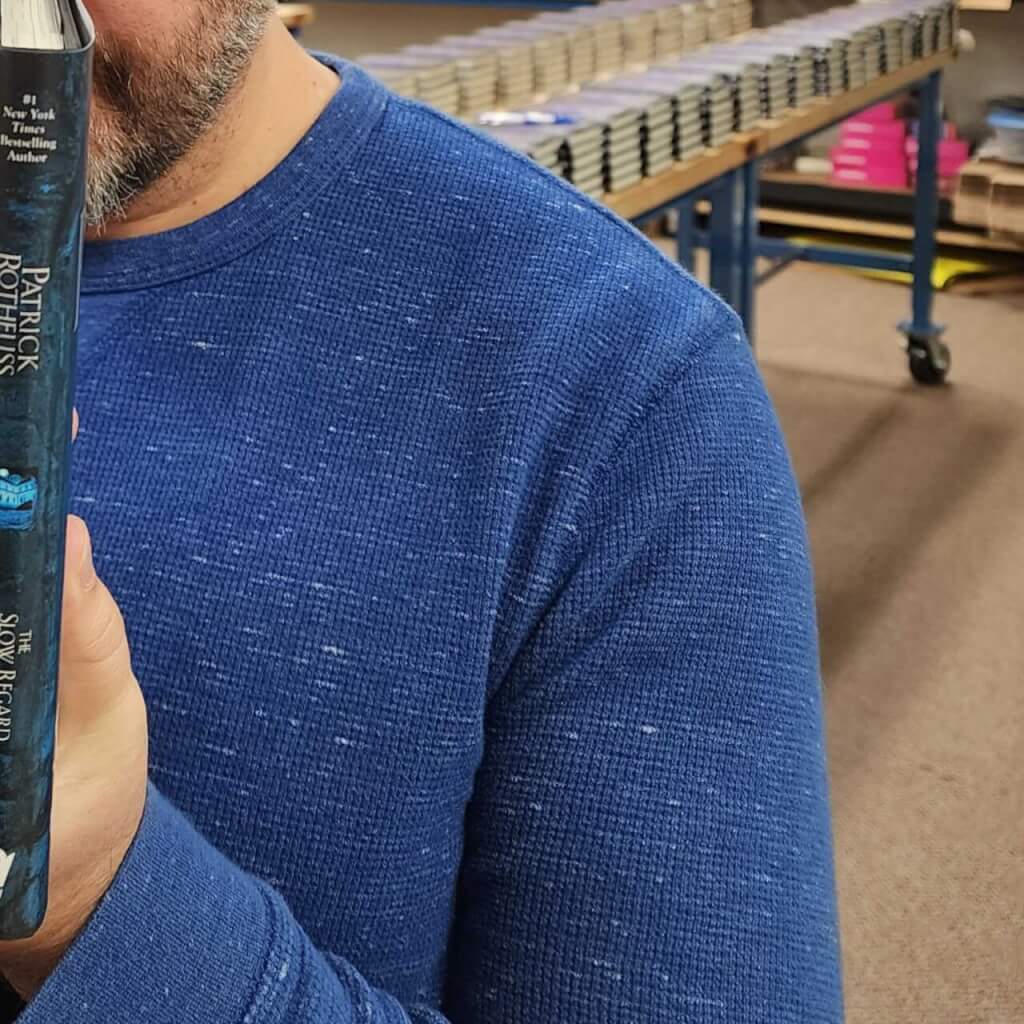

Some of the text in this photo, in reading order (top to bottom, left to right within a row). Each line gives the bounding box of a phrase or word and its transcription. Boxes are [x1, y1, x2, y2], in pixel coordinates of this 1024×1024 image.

[2, 105, 56, 121] New York
[11, 121, 45, 135] Times
[0, 134, 57, 151] Bestselling
[7, 149, 48, 163] Author
[16, 265, 51, 374] PATRICK
[17, 629, 33, 655] THE
